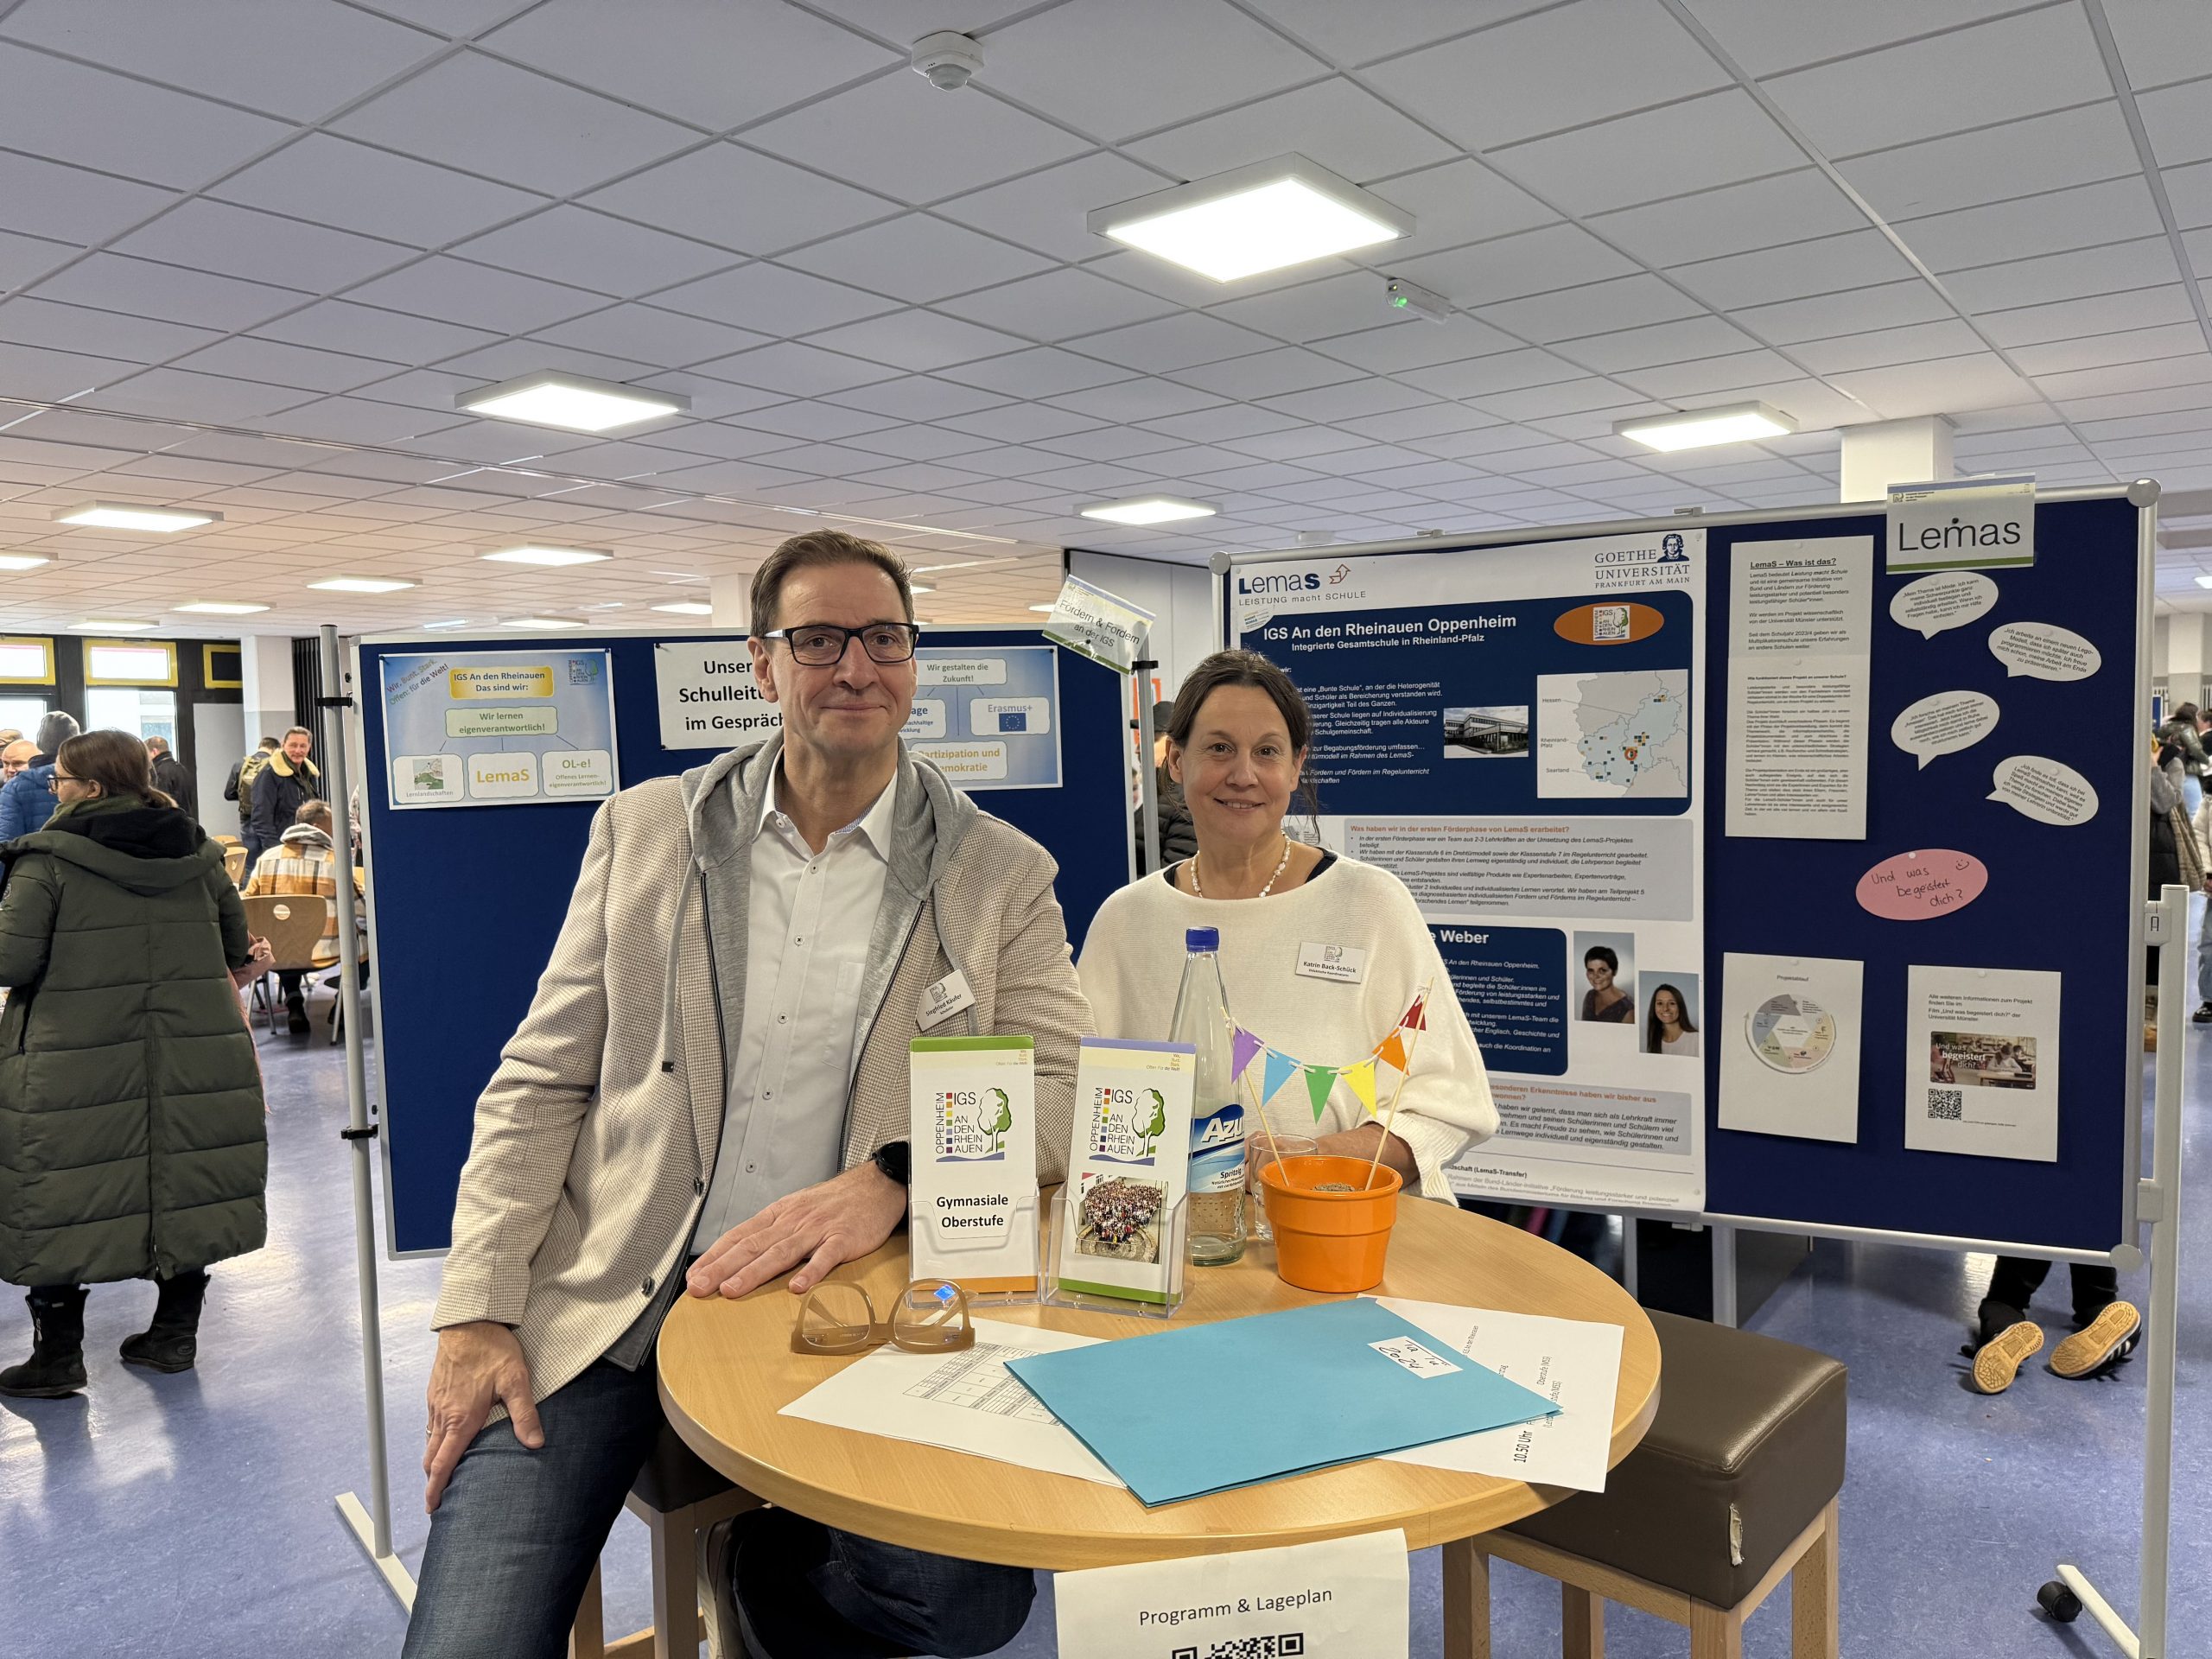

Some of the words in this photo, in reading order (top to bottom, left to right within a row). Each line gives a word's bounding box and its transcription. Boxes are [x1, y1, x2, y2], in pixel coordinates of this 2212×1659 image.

[1900, 522, 2020, 550] Lemas
[1595, 550, 1656, 563] GOETHE
[1595, 563, 1690, 579] UNIVERSITÄT
[1239, 596, 1287, 606] LEISTUNG
[1325, 591, 1366, 600] SCHULE
[1060, 600, 1094, 622] Fördern
[1096, 618, 1103, 627] &
[1106, 622, 1140, 645] Fordern
[1263, 627, 1287, 640] IGS
[1292, 626, 1311, 639] An
[1315, 626, 1340, 638] den
[1345, 622, 1423, 636] Rheinauen
[1427, 615, 1516, 633] Oppenheim
[1074, 624, 1084, 632] an
[1086, 628, 1099, 639] der
[1100, 633, 1115, 646] IGS
[1292, 642, 1334, 652] Integrierte
[1338, 638, 1399, 649] Gesamtschule
[1402, 637, 1410, 645] in
[1413, 633, 1484, 645] Rheinland-Pfalz
[704, 661, 753, 674] Unser
[420, 677, 430, 686] die
[431, 664, 449, 679] Welt!
[459, 723, 545, 735] eigenverantwortlich!
[686, 717, 706, 730] im
[982, 748, 1000, 757] und
[562, 759, 591, 769] OL-e!
[940, 763, 988, 772] emokratie
[477, 769, 530, 784] LemaS
[1872, 871, 1895, 884] Und
[1907, 868, 1929, 878] was
[1897, 879, 1950, 899] begeistert
[1440, 930, 1489, 944] Weber
[926, 1002, 946, 1017] Siegfried
[1942, 1052, 1986, 1061] begeistert
[1111, 1090, 1133, 1103] IGS
[1530, 1087, 1578, 1096] Erkenntnisse
[954, 1092, 976, 1105] IGS
[1090, 1088, 1103, 1151] OPPENHEIM
[1109, 1114, 1122, 1122] AN
[1109, 1123, 1128, 1133] DEN
[955, 1135, 982, 1143] RHEIN
[1108, 1135, 1135, 1144] RHEIN
[955, 1144, 982, 1153] AUEN
[1107, 1145, 1134, 1154] AUEN
[1220, 1168, 1242, 1179] Spritzig
[937, 1194, 1008, 1210] Gymnasiale
[942, 1215, 1003, 1228] Oberstufe
[1518, 1431, 1533, 1442] Uhr
[1514, 1444, 1530, 1463] 10.50
[1140, 1604, 1230, 1625] Programm
[1237, 1599, 1250, 1612] &
[1257, 1589, 1332, 1611] Lageplan
